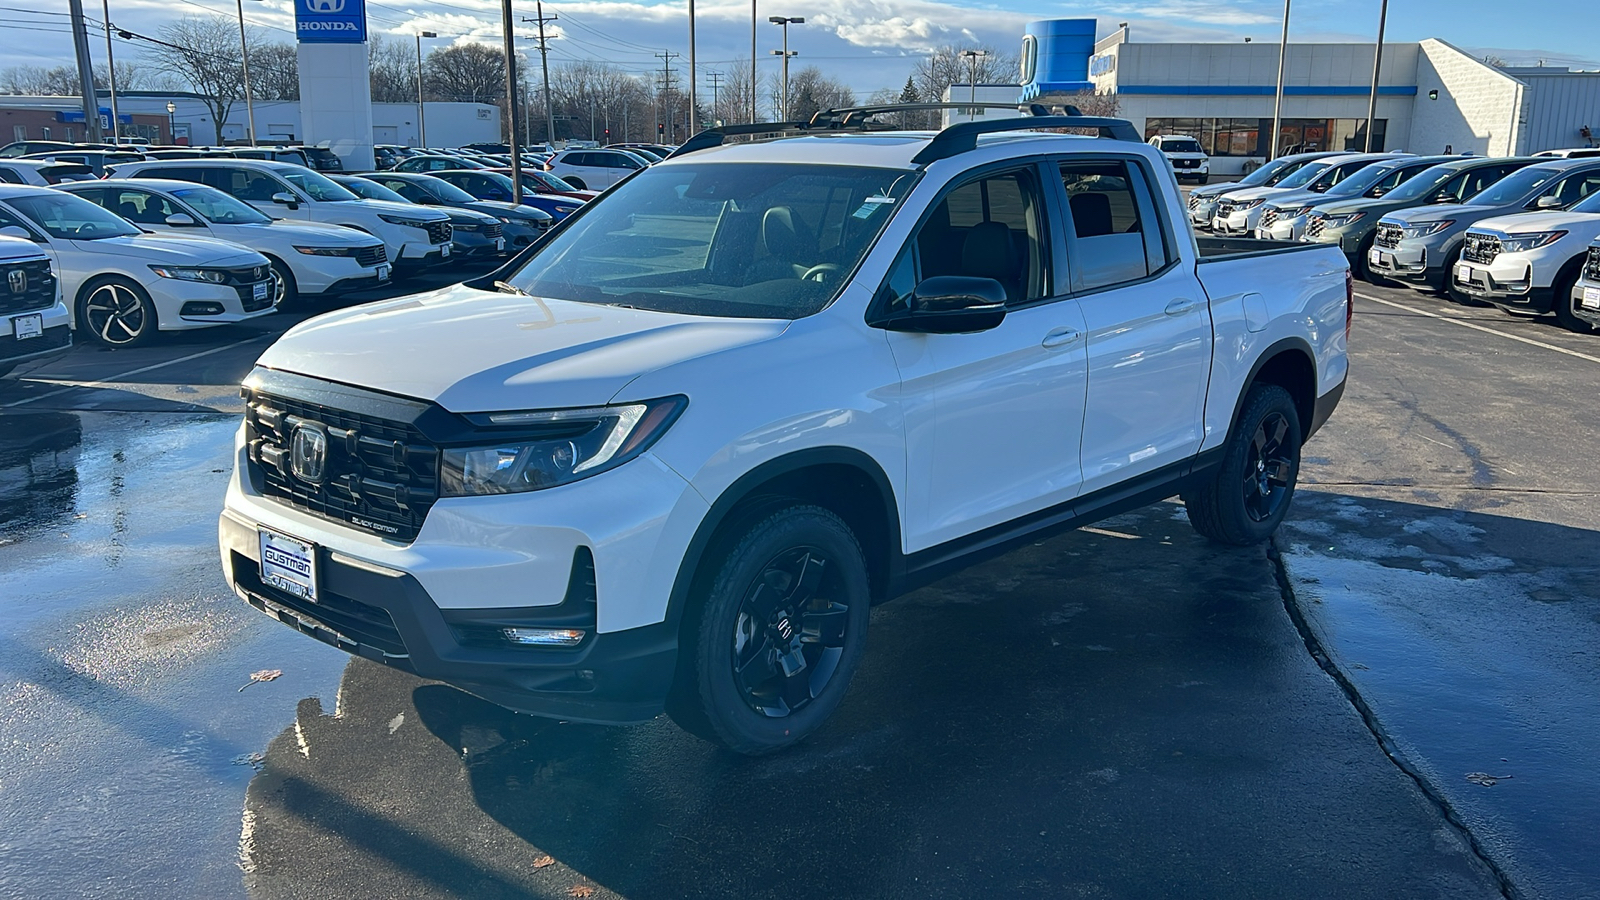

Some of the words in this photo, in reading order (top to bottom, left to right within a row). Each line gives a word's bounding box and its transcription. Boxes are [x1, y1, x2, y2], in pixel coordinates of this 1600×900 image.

[297, 21, 359, 31] HONDA
[351, 516, 373, 528] BLACK
[372, 522, 399, 534] EDITION
